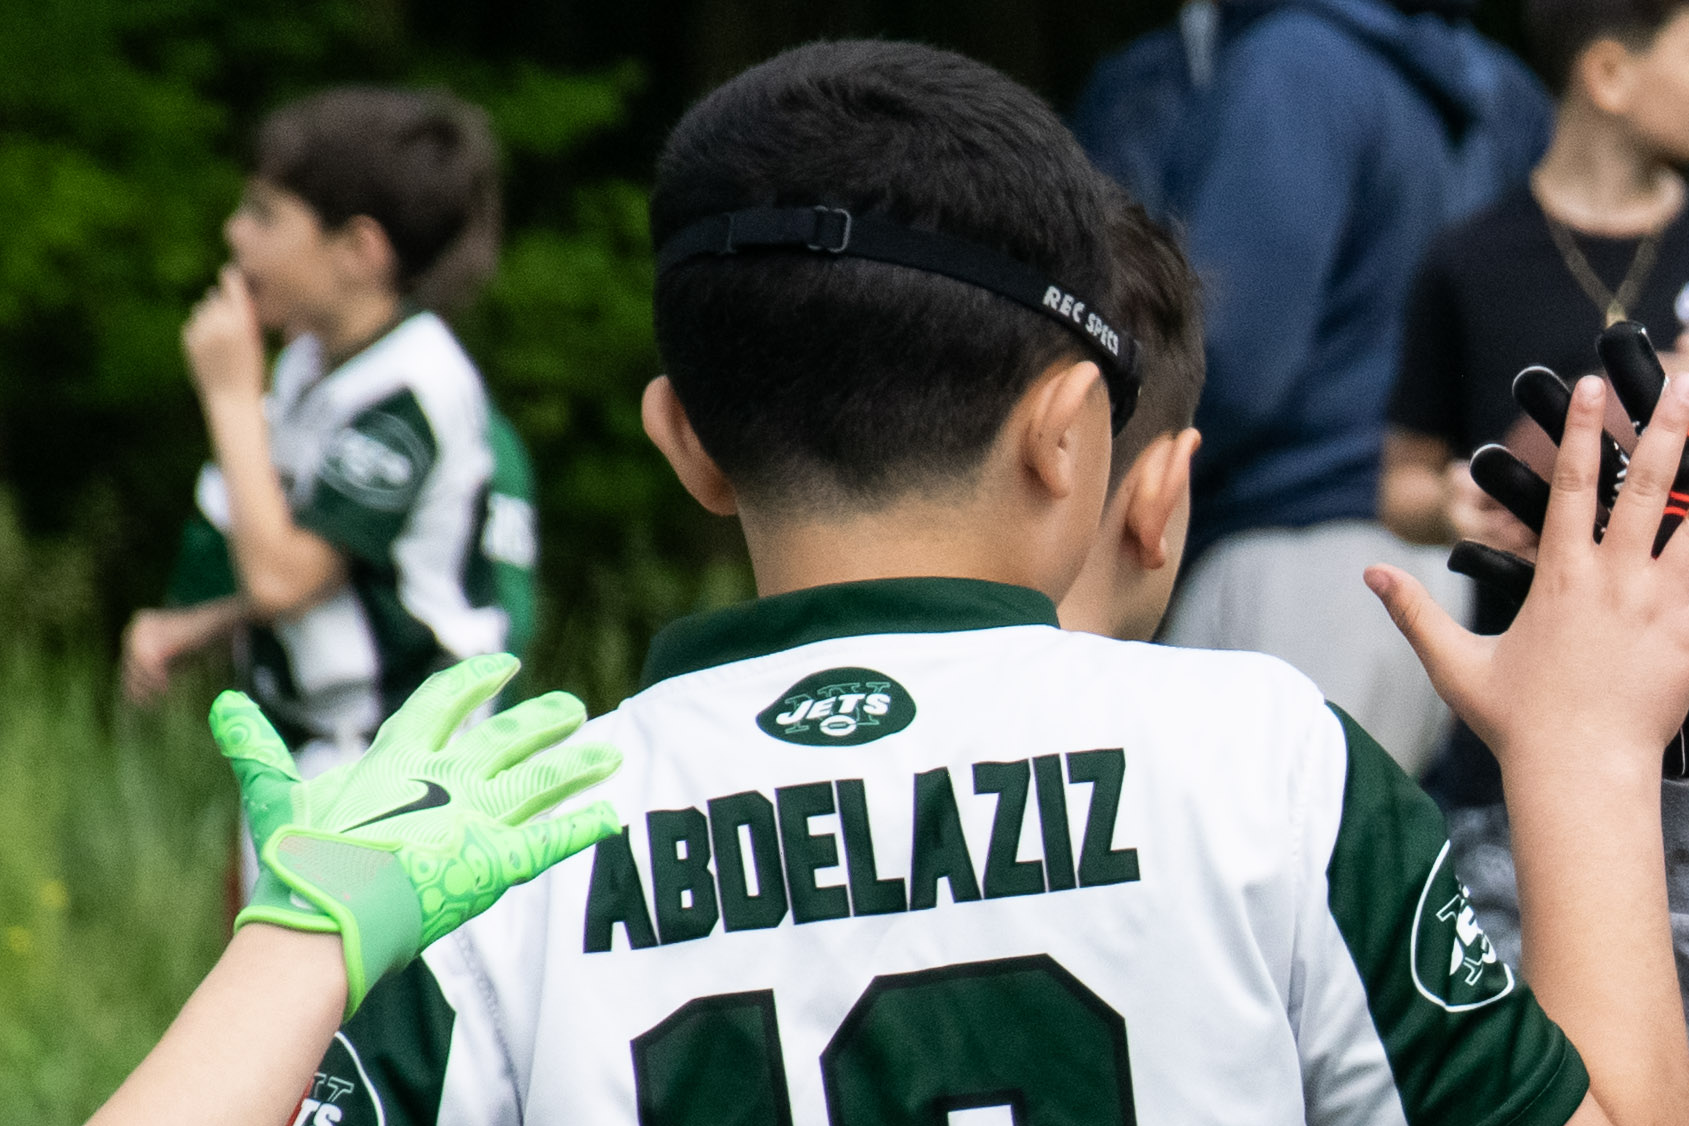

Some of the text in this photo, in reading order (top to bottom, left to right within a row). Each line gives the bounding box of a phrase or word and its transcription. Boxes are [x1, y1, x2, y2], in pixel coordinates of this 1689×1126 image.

[1042, 285, 1086, 324] REC
[775, 693, 892, 726] JETS
[583, 748, 1141, 954] ABDELAZIZ
